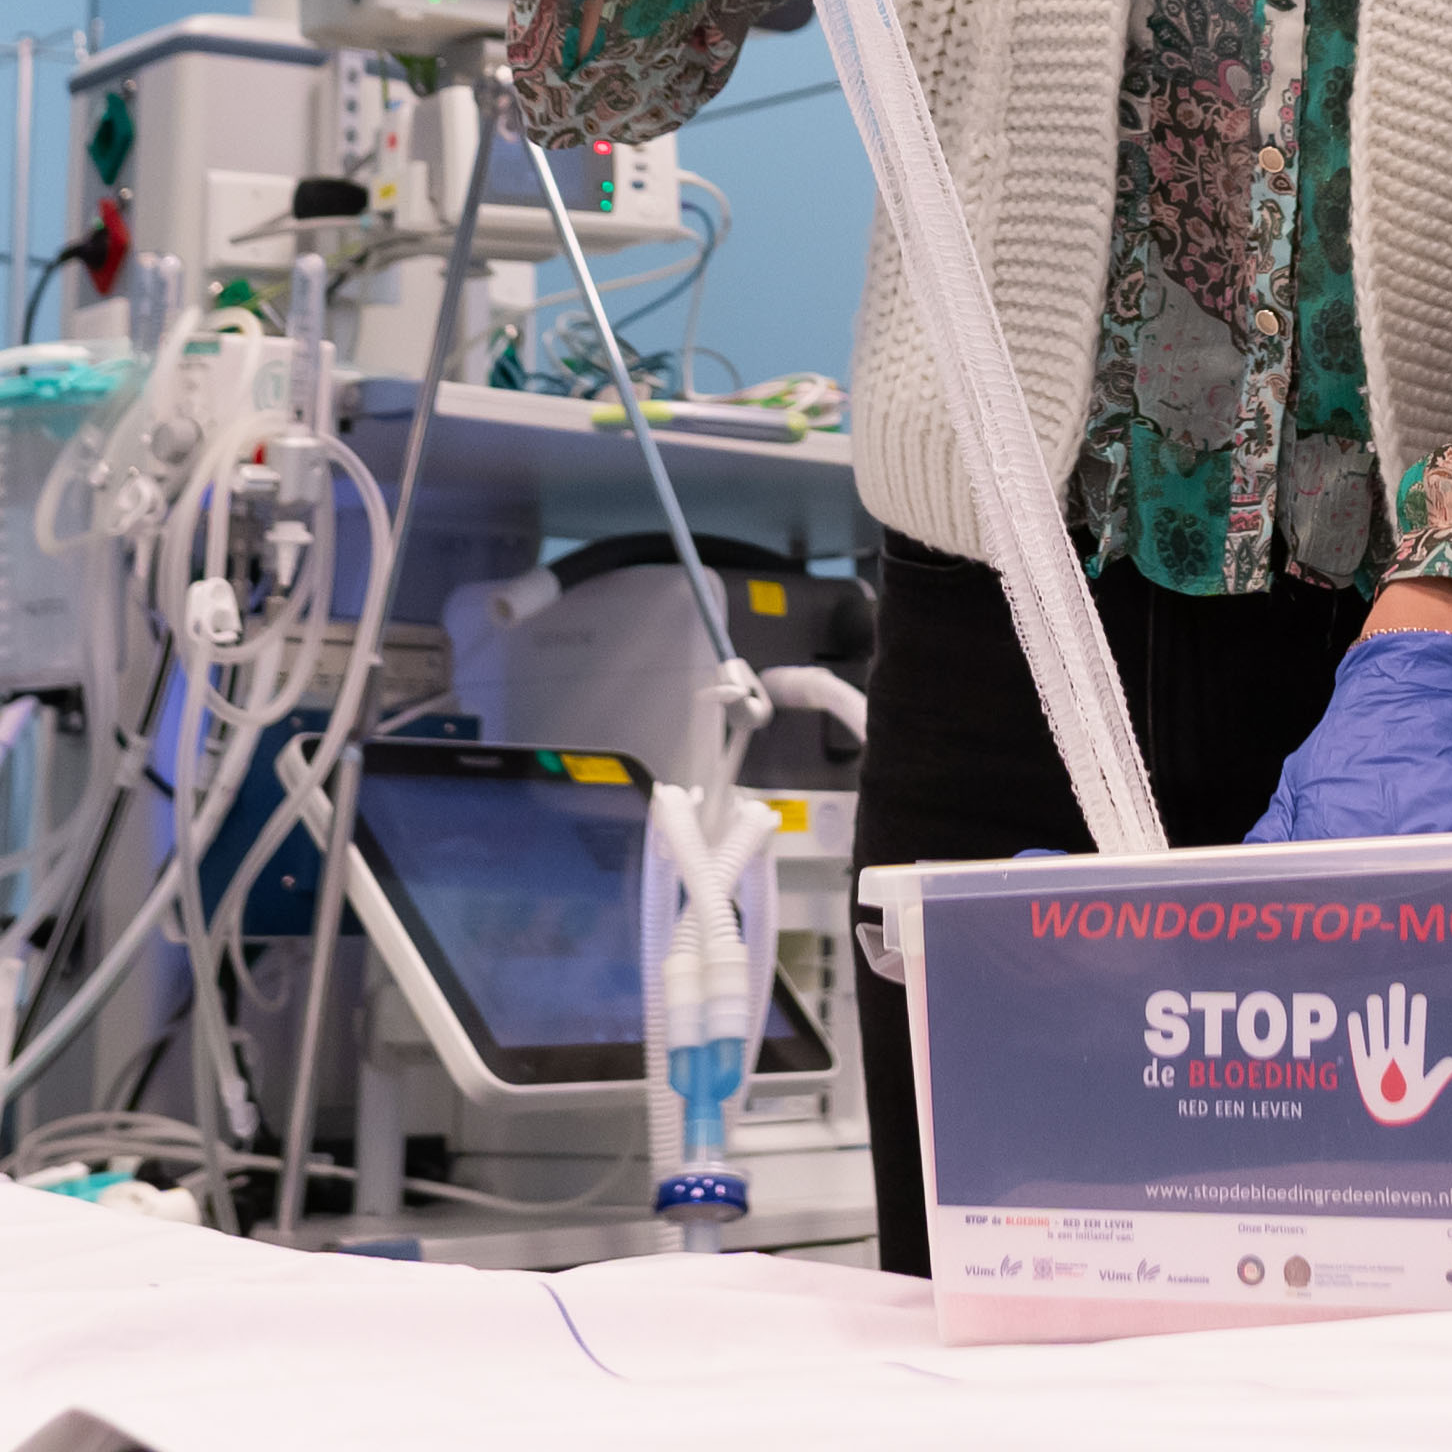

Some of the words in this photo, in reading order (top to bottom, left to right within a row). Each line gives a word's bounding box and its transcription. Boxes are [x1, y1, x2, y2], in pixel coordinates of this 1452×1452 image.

[1143, 989, 1338, 1060] STOP
[1142, 1057, 1175, 1088] de
[1188, 1059, 1338, 1090] BLOEDING
[1178, 1099, 1209, 1117] RED
[1215, 1100, 1245, 1118] EEN
[1252, 1101, 1303, 1120] LEVEN
